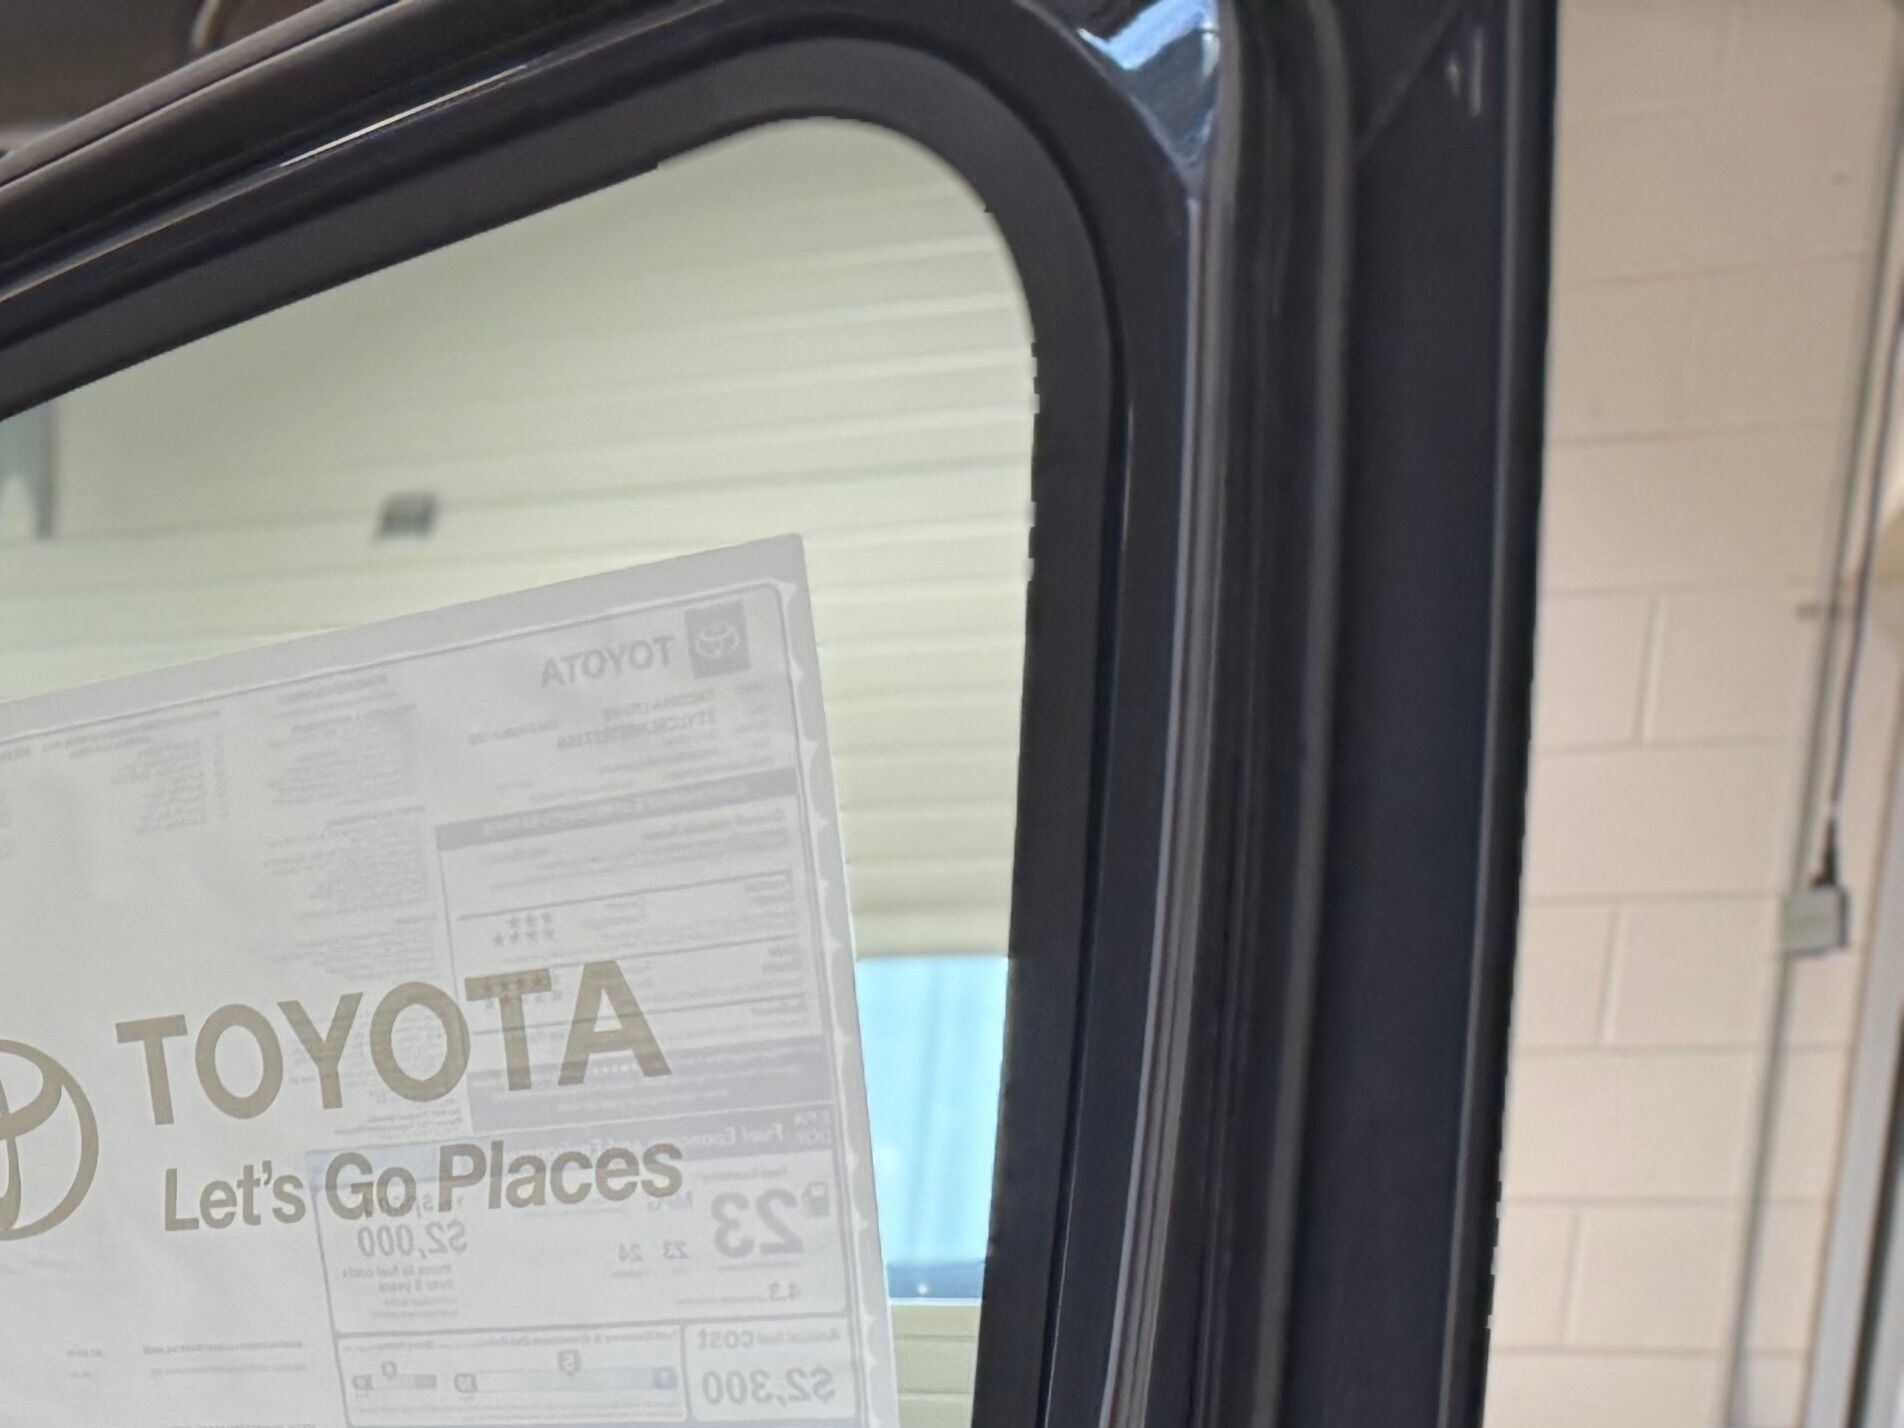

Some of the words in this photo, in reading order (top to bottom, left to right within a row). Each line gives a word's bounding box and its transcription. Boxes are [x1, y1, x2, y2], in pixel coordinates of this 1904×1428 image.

[115, 960, 673, 1126] TOYOTA
[164, 1160, 307, 1232] Let's
[325, 1152, 417, 1221] Go
[438, 1140, 683, 1213] Places
